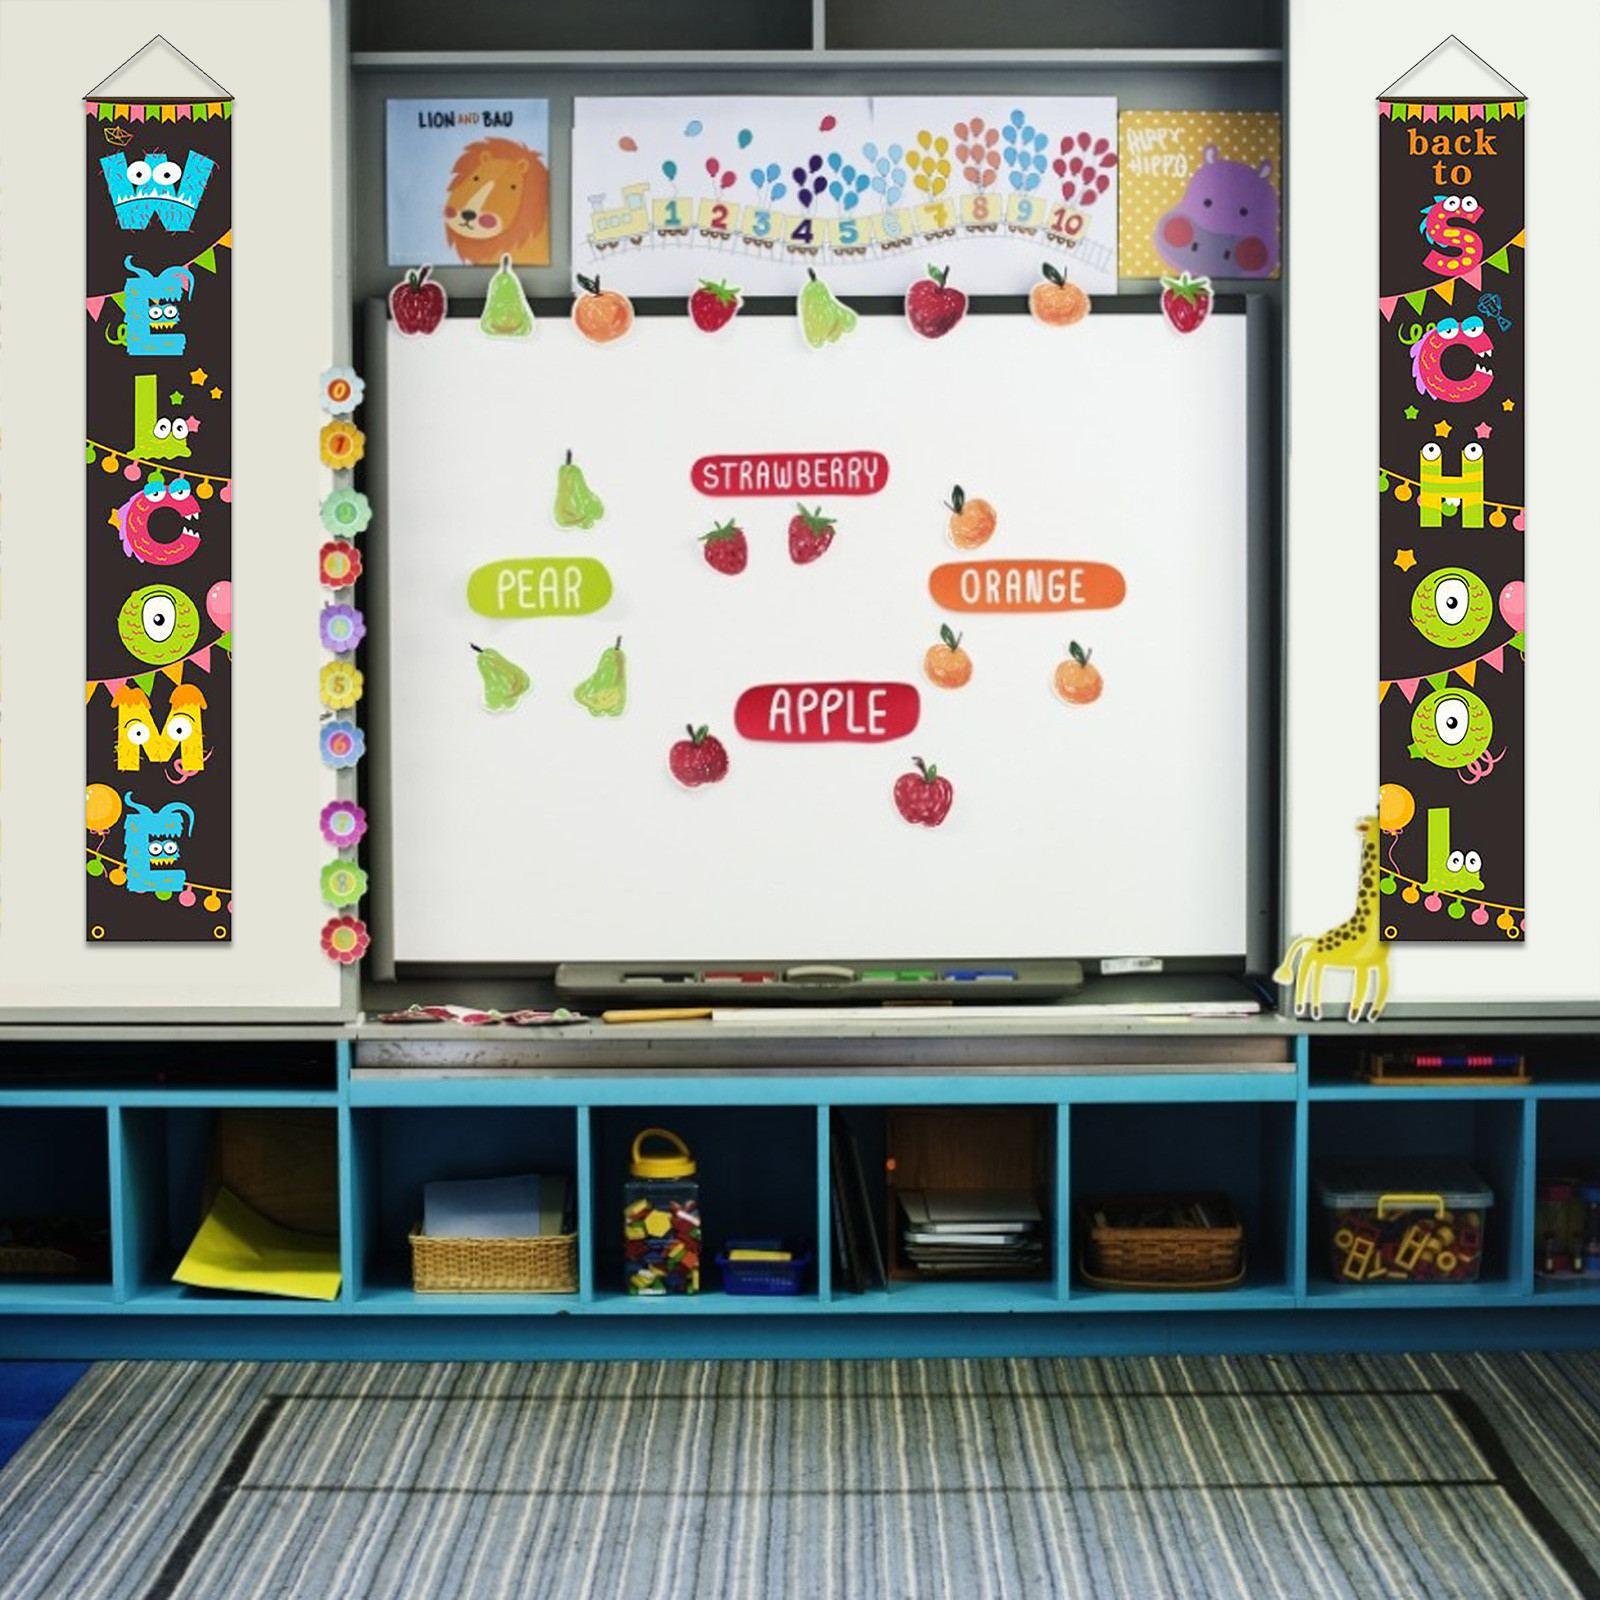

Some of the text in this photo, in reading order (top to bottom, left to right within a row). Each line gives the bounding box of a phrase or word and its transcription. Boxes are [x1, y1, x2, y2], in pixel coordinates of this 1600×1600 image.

[419, 111, 513, 128] LION AND BAU
[1407, 127, 1497, 156] back
[1432, 159, 1473, 185] to
[664, 195, 1084, 244] 1 2 3 4 5 6 7 8 9 10
[703, 457, 878, 490] STRAWBERRY
[498, 566, 582, 610] PEAR
[961, 568, 1086, 604] ORANGE
[334, 676, 345, 694] 5
[769, 688, 887, 735] APPLE
[333, 736, 347, 752] 6
